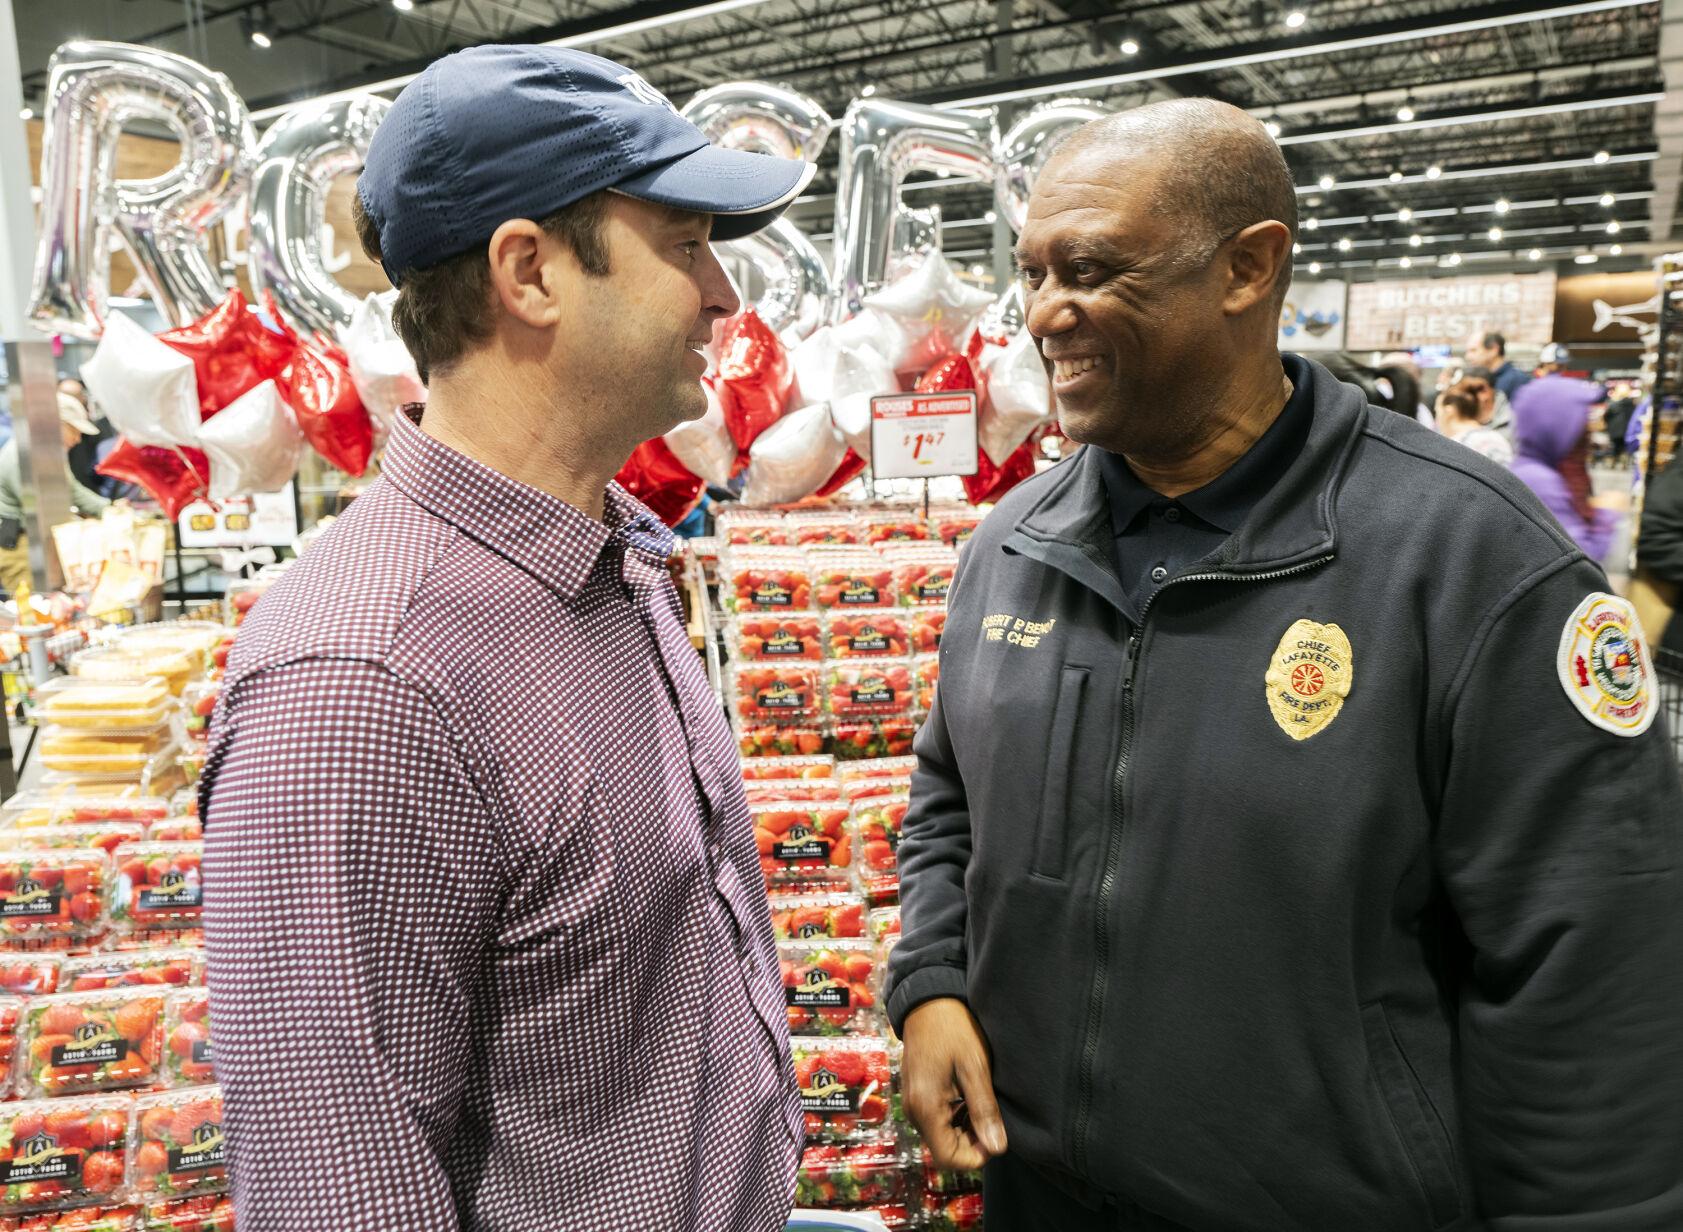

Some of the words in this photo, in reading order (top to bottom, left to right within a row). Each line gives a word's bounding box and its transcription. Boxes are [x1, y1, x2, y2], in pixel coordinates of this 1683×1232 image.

[1405, 314, 1489, 338] BEST
[1006, 631, 1041, 648] CHIEF
[1297, 640, 1331, 653] CHIEF
[1282, 652, 1341, 672] LAFAYETTE
[1280, 691, 1300, 707] FIRE
